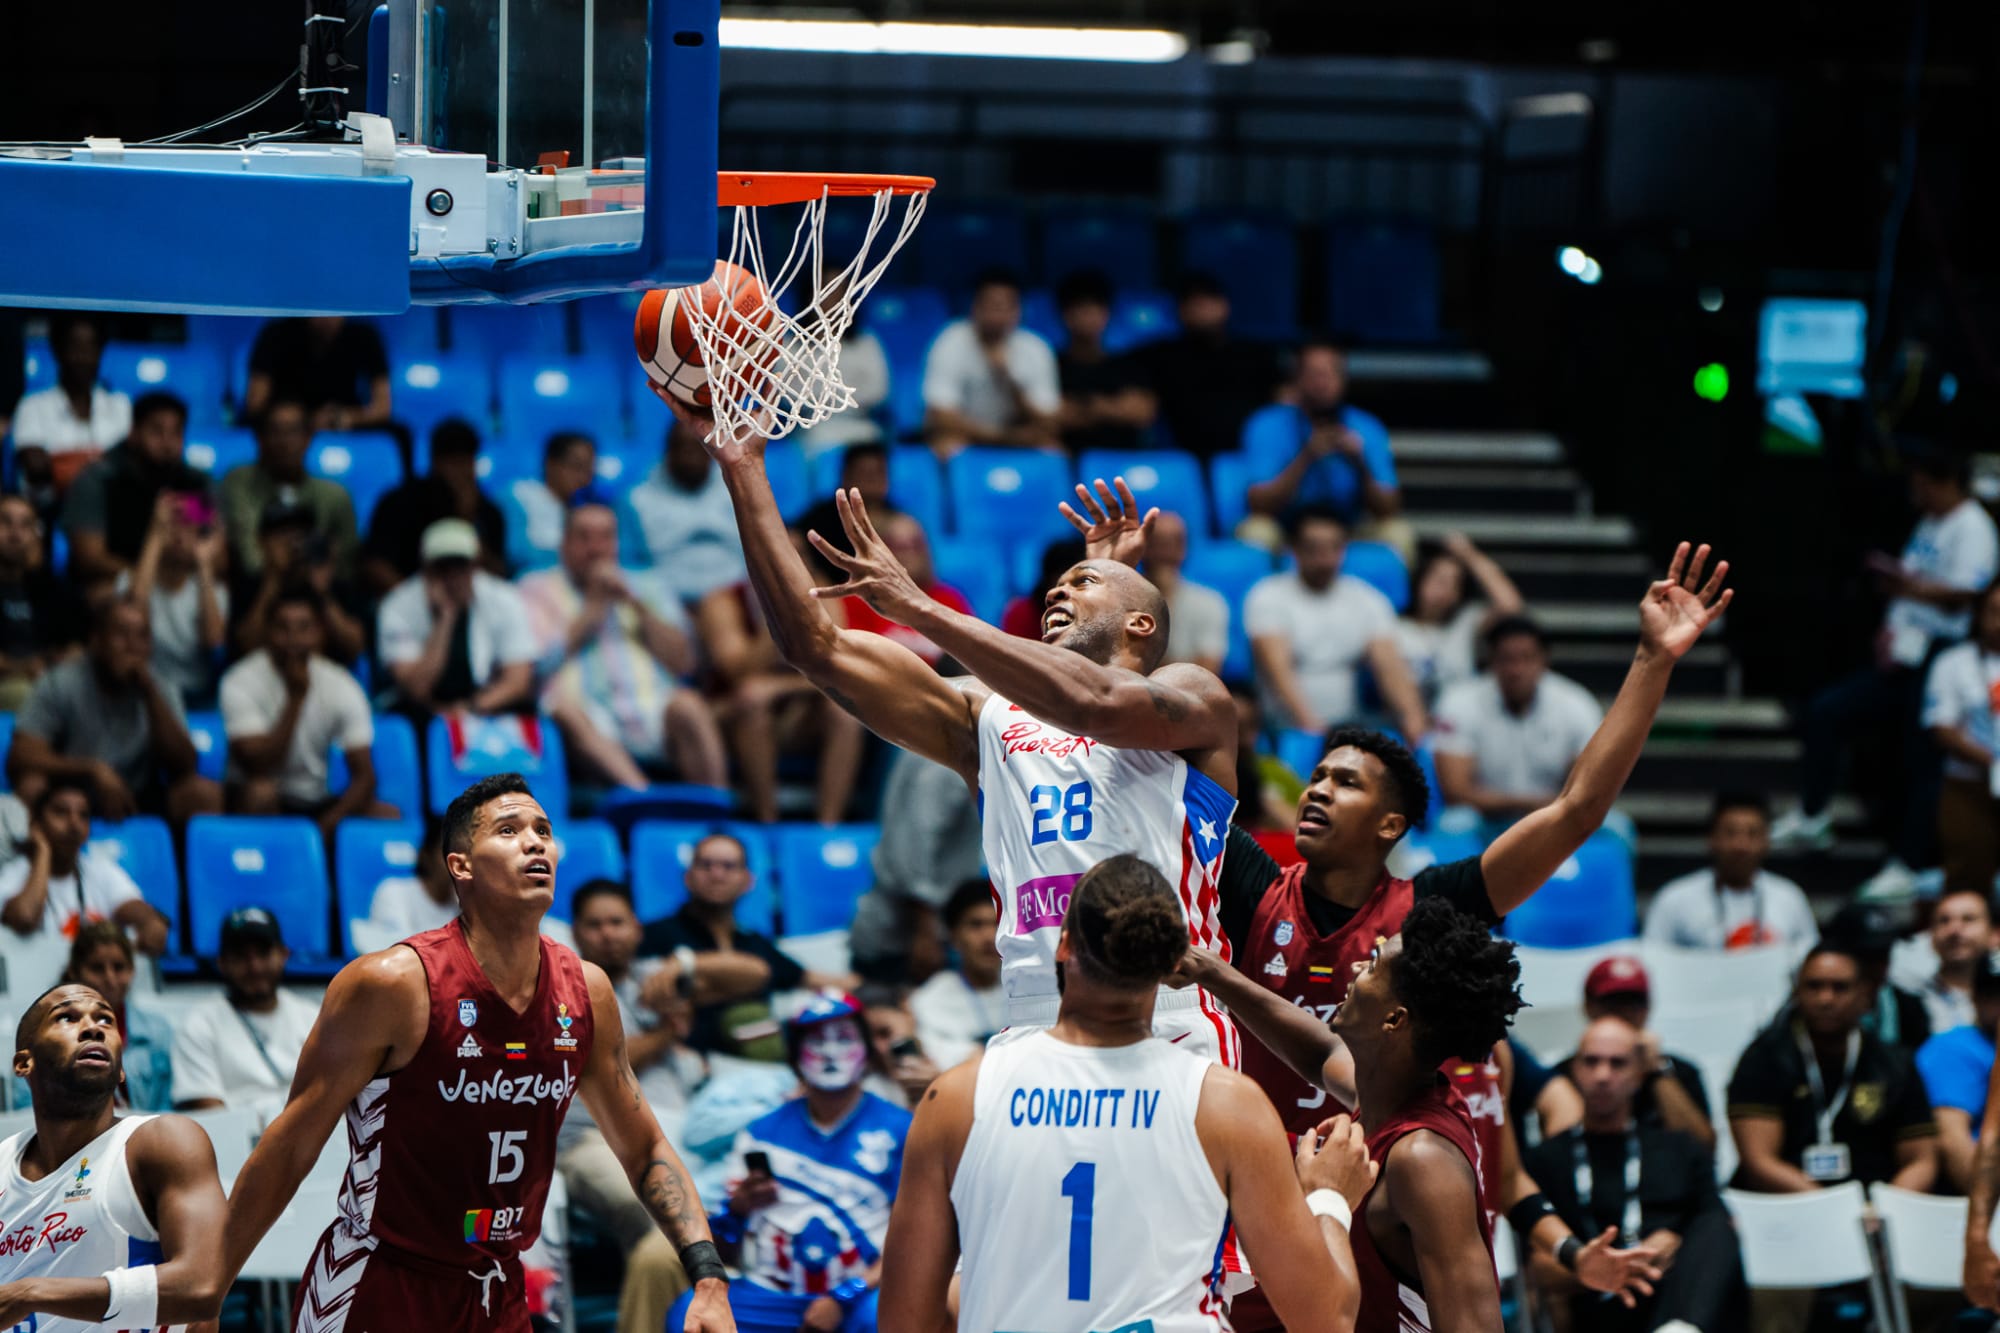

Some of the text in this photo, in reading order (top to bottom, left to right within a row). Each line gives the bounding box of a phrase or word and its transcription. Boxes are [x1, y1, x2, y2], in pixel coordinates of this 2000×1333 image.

[1001, 721, 1073, 762] Puerto
[1030, 780, 1093, 846] 28
[1009, 1087, 1161, 1129] CONDITT IV
[488, 1130, 528, 1185] 15
[37, 1211, 88, 1254] Rico
[1061, 1161, 1097, 1302] 1
